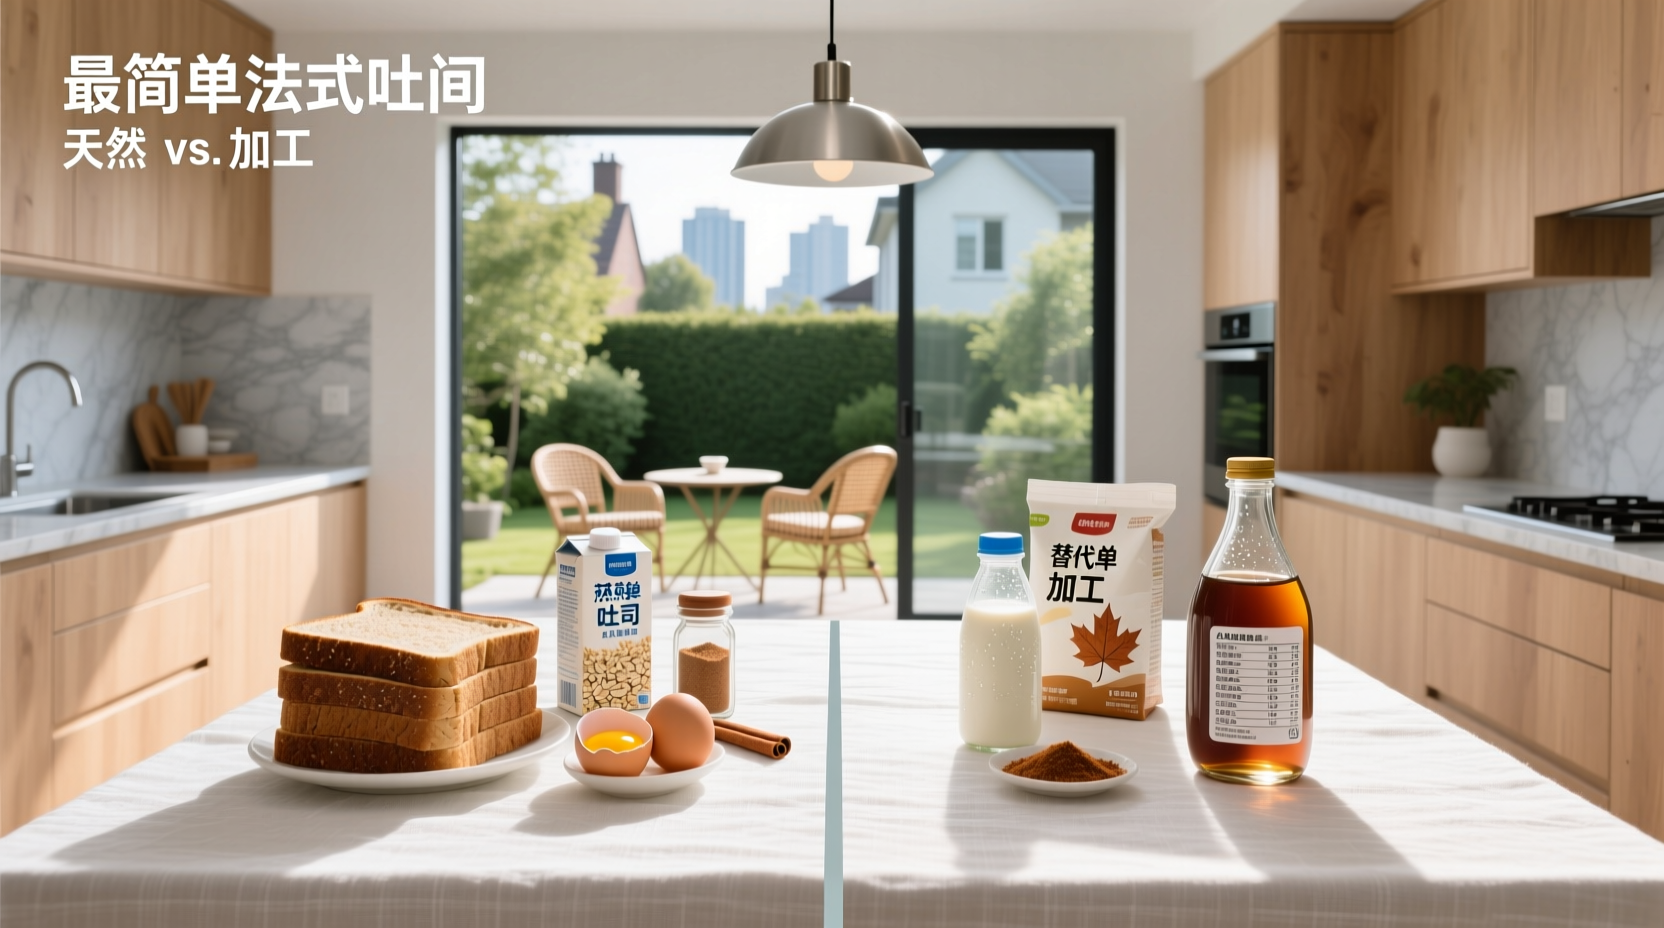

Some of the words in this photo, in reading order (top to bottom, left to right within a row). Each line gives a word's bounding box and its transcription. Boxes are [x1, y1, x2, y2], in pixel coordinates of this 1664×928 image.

[1051, 543, 1117, 571] 替代单
[1046, 572, 1104, 604] 加工
[597, 603, 640, 627] 吐司
